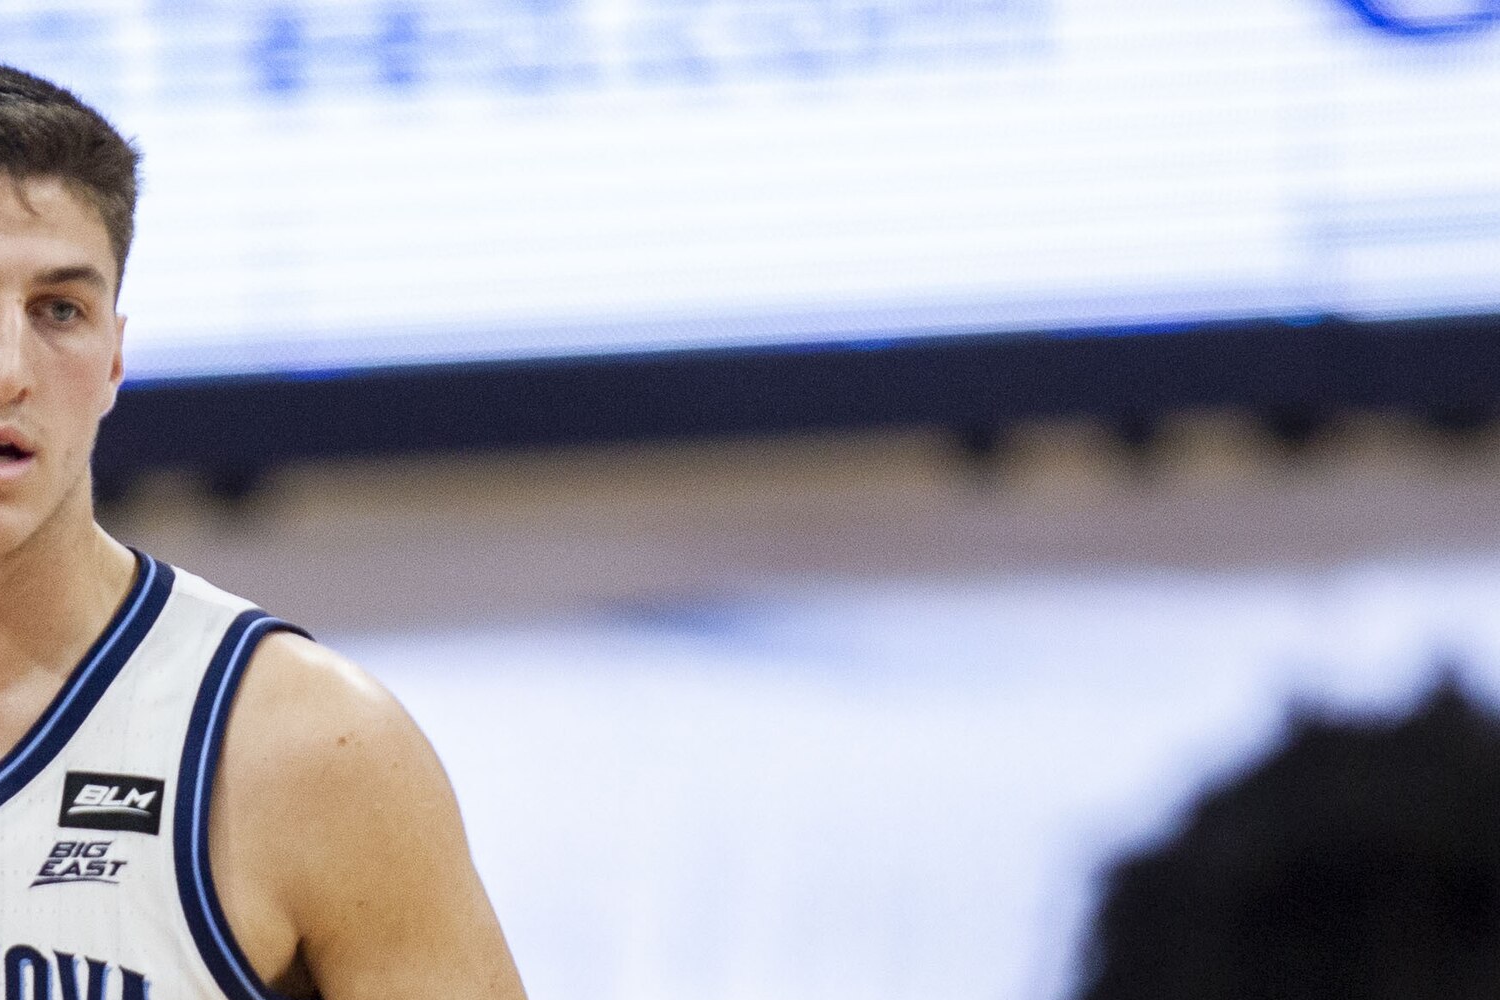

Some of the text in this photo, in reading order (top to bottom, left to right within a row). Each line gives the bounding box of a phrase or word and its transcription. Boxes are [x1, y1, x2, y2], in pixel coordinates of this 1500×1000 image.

[73, 783, 157, 810] BLM
[48, 841, 113, 858] BIG
[36, 859, 128, 877] EAST
